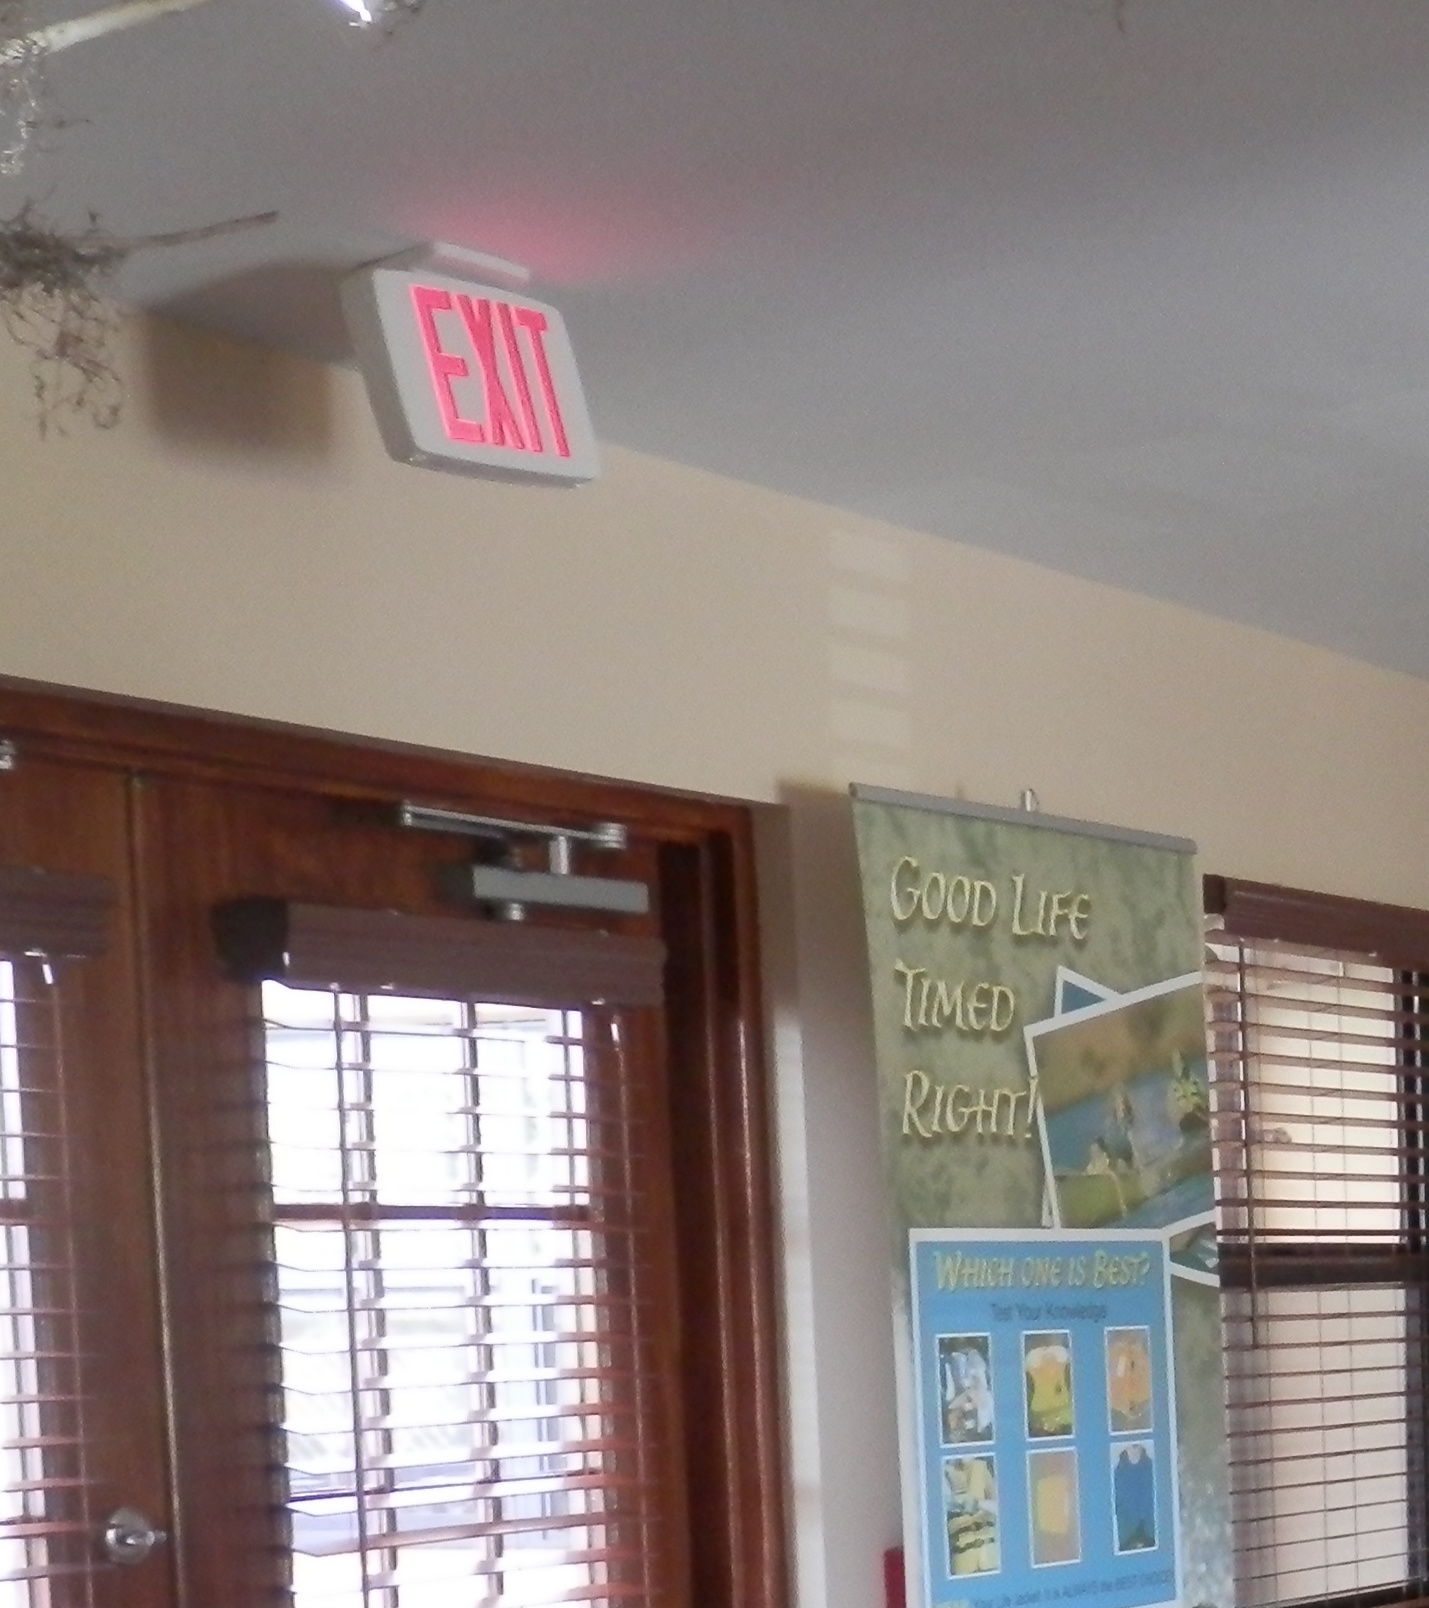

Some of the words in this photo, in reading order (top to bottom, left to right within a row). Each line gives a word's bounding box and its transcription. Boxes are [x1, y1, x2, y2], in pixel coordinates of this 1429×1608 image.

[410, 284, 571, 458] EXIT
[890, 856, 997, 926] GOOD
[1011, 873, 1091, 940] LIFE
[893, 957, 1016, 1033] TIMED
[902, 1069, 1039, 1139] RIGHT!
[934, 1250, 1015, 1292] WHICH
[1021, 1256, 1062, 1287] ONE
[1068, 1257, 1085, 1287] IS
